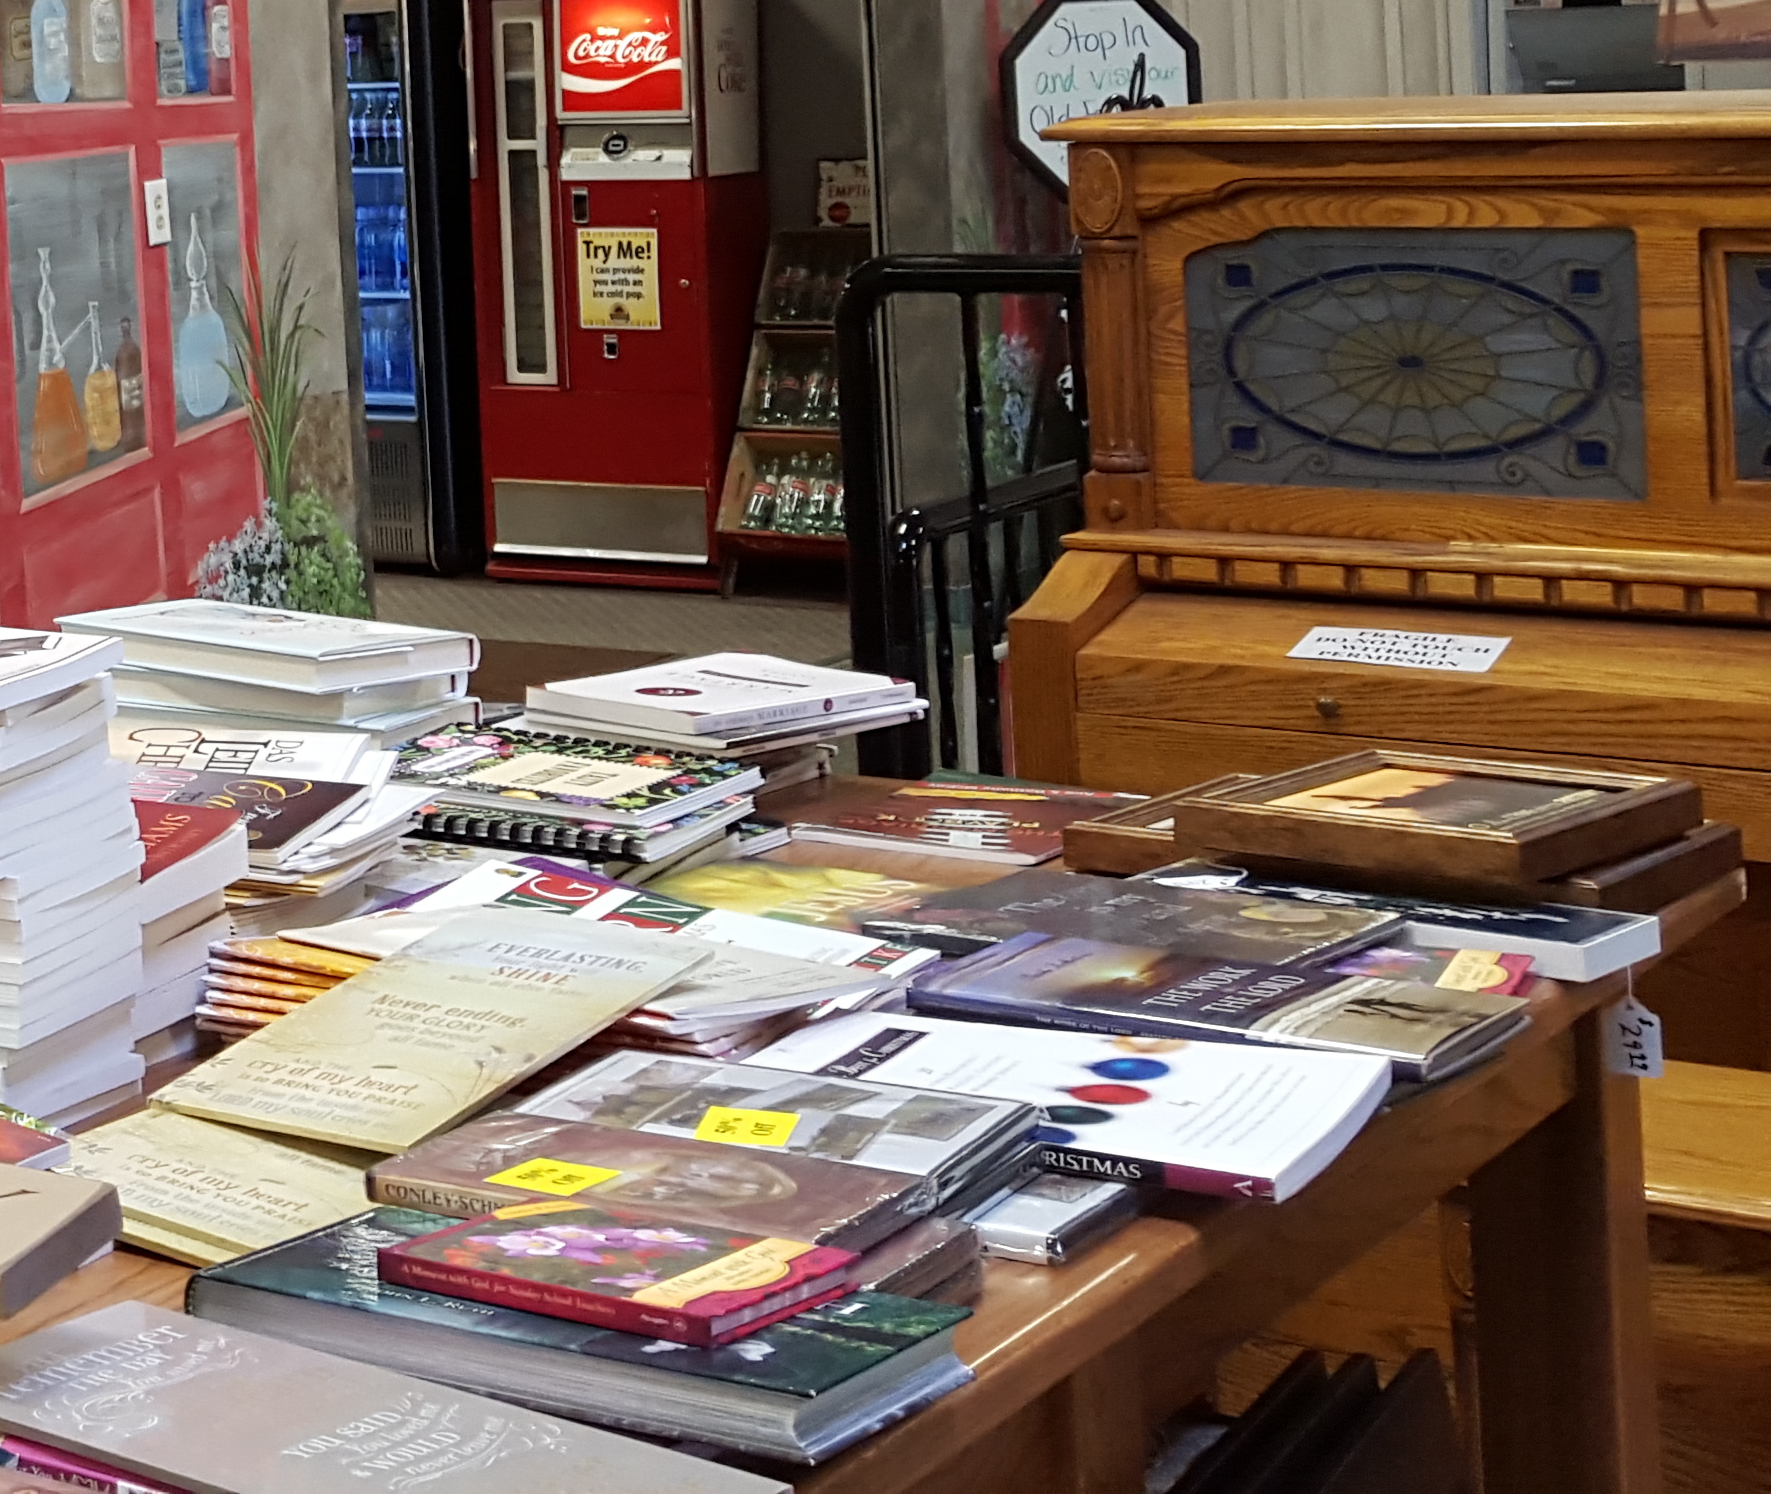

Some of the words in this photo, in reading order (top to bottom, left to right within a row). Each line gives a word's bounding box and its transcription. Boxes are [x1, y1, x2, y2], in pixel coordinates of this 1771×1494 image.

[1048, 17, 1117, 61] Stop
[1122, 17, 1151, 48] In
[1035, 64, 1079, 95] and
[581, 239, 612, 264] Try
[616, 239, 652, 260] Me!
[609, 277, 631, 288] with
[611, 265, 646, 278] provide
[1315, 636, 1348, 644] DO
[1358, 637, 1399, 647] NOT
[1411, 642, 1492, 654] TOUCH
[1357, 630, 1460, 644] FRAGILE
[1318, 650, 1461, 668] PERMISSION
[1342, 644, 1449, 659] WITHOUT
[489, 964, 577, 987] SHINE
[1200, 989, 1246, 1015] THE
[1242, 973, 1306, 1005] LORD
[365, 1005, 418, 1027] YOUR
[422, 1015, 491, 1037] GLORY
[372, 993, 439, 1017] Never
[443, 1006, 529, 1030] ending.
[247, 1059, 295, 1080] cry
[358, 1073, 419, 1098] heart
[279, 1424, 342, 1461] YOU
[362, 1430, 462, 1475] WOULD
